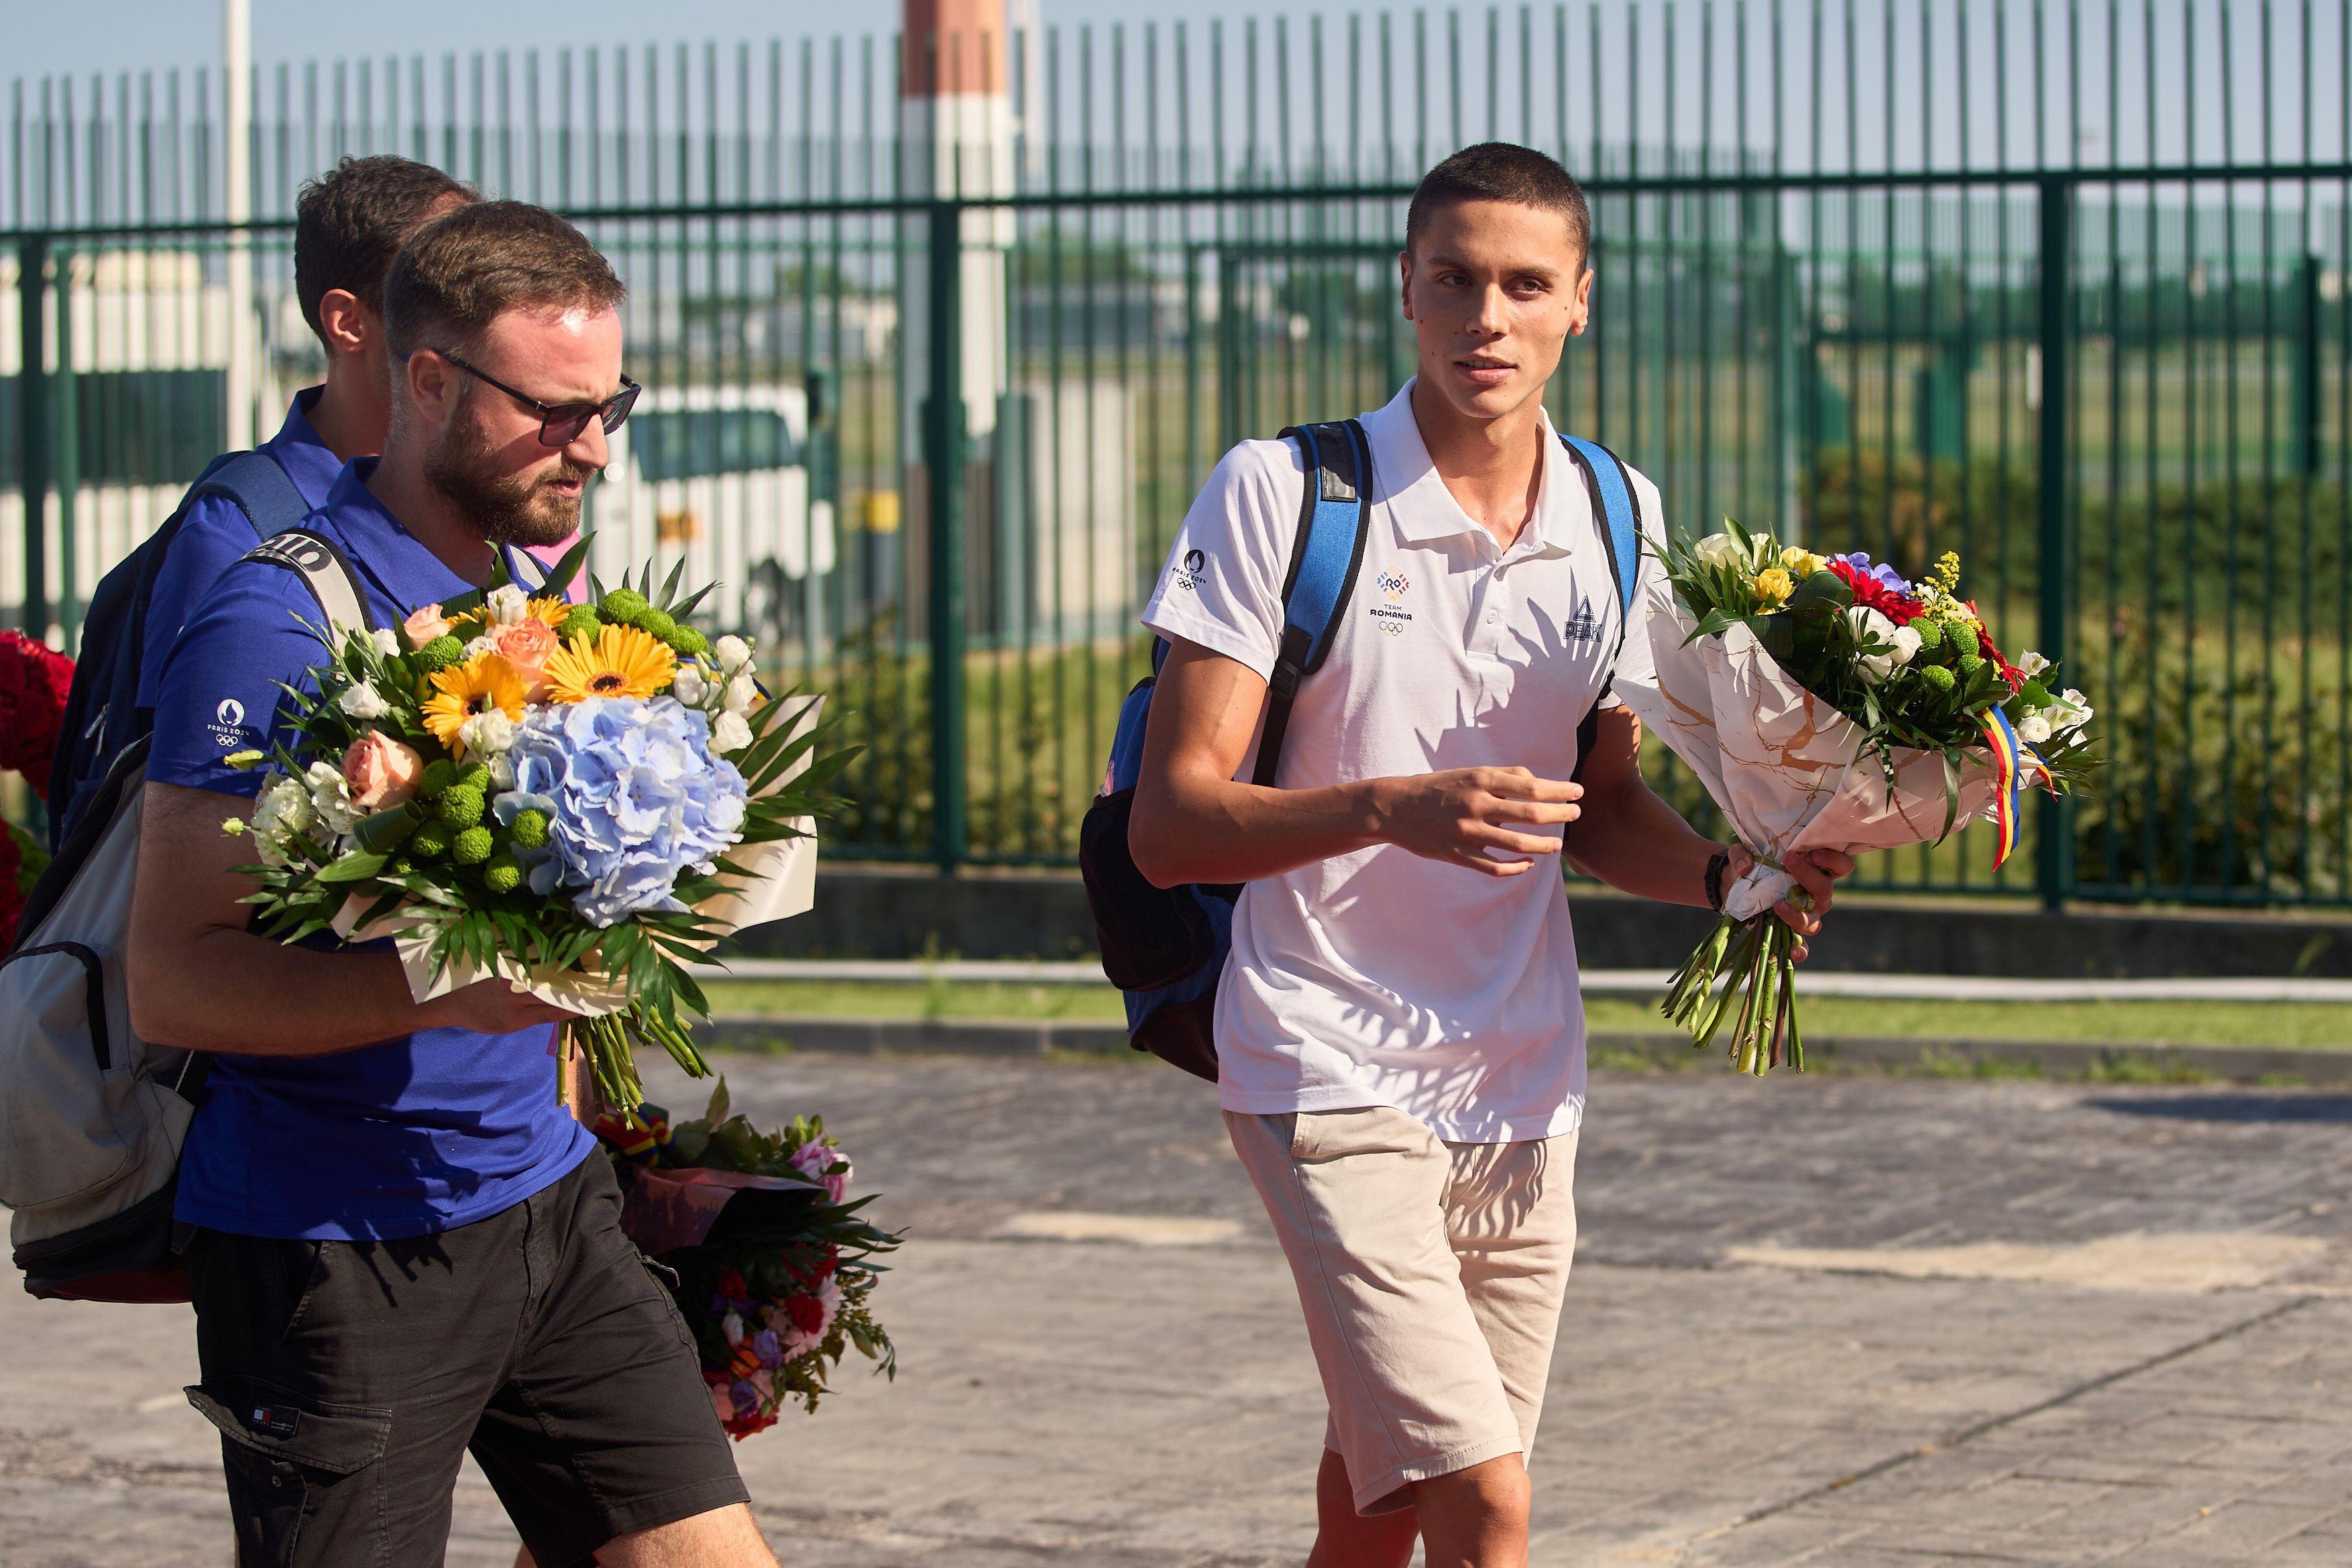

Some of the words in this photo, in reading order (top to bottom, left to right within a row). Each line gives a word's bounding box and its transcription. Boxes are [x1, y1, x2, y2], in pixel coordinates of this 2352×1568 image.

[1172, 567, 1190, 577] PARIS
[1190, 575, 1207, 584] 2024
[1369, 609, 1412, 621] ROMANIA
[1563, 621, 1603, 642] PEAK
[207, 724, 228, 733] PARIS
[230, 728, 249, 736] 2024
